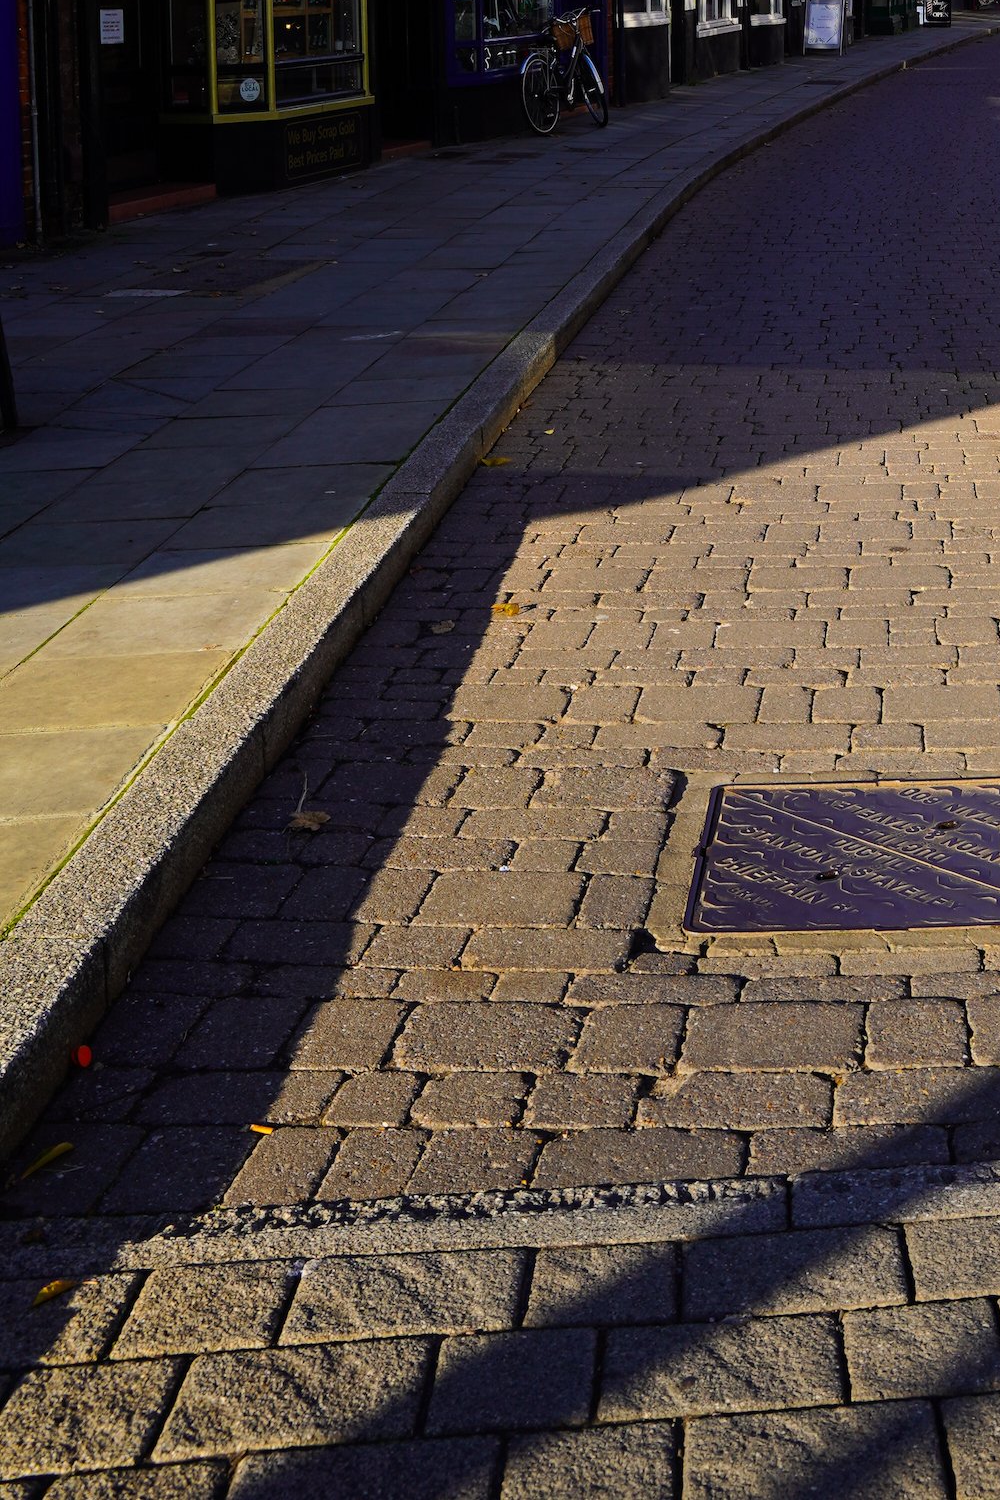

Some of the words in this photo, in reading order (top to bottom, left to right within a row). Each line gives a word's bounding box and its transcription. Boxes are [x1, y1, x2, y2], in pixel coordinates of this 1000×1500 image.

[288, 131, 301, 146] We
[338, 117, 356, 135] Gold
[738, 827, 837, 865] STANTON
[713, 857, 831, 905] CHIEFTAIN
